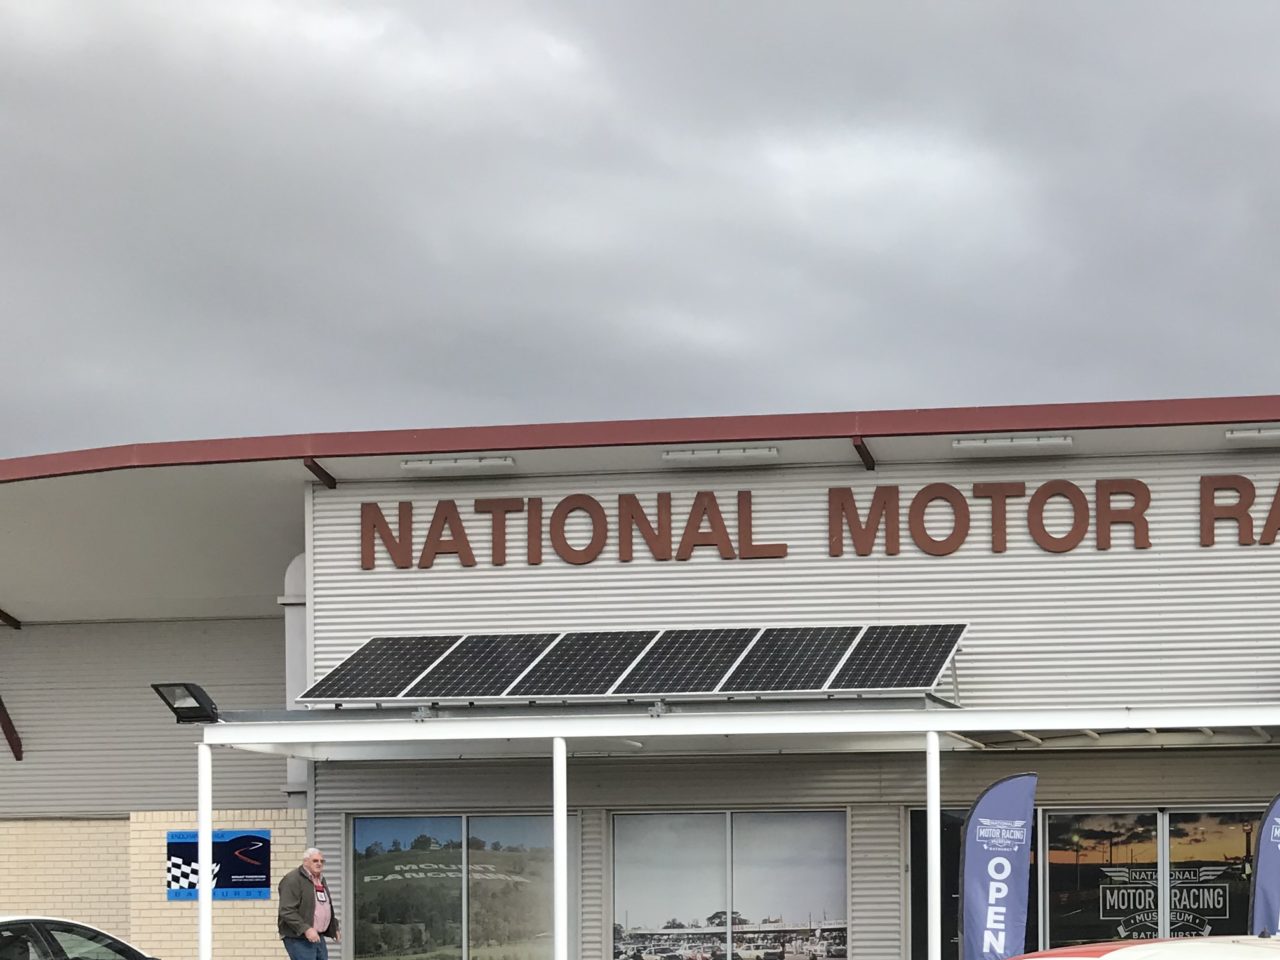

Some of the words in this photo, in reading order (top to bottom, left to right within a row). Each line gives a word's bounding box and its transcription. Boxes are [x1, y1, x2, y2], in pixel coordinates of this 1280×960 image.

[360, 490, 788, 570] NATIONAL
[828, 478, 1152, 557] MOTOR
[979, 828, 1000, 838] MOTOR
[1001, 829, 1024, 840] RACING
[394, 863, 497, 871] MOUNT
[983, 857, 1011, 954] OPEN
[1106, 889, 1155, 910] MOTOR
[1171, 888, 1224, 909] RACING
[1136, 911, 1193, 923] MUSEUM
